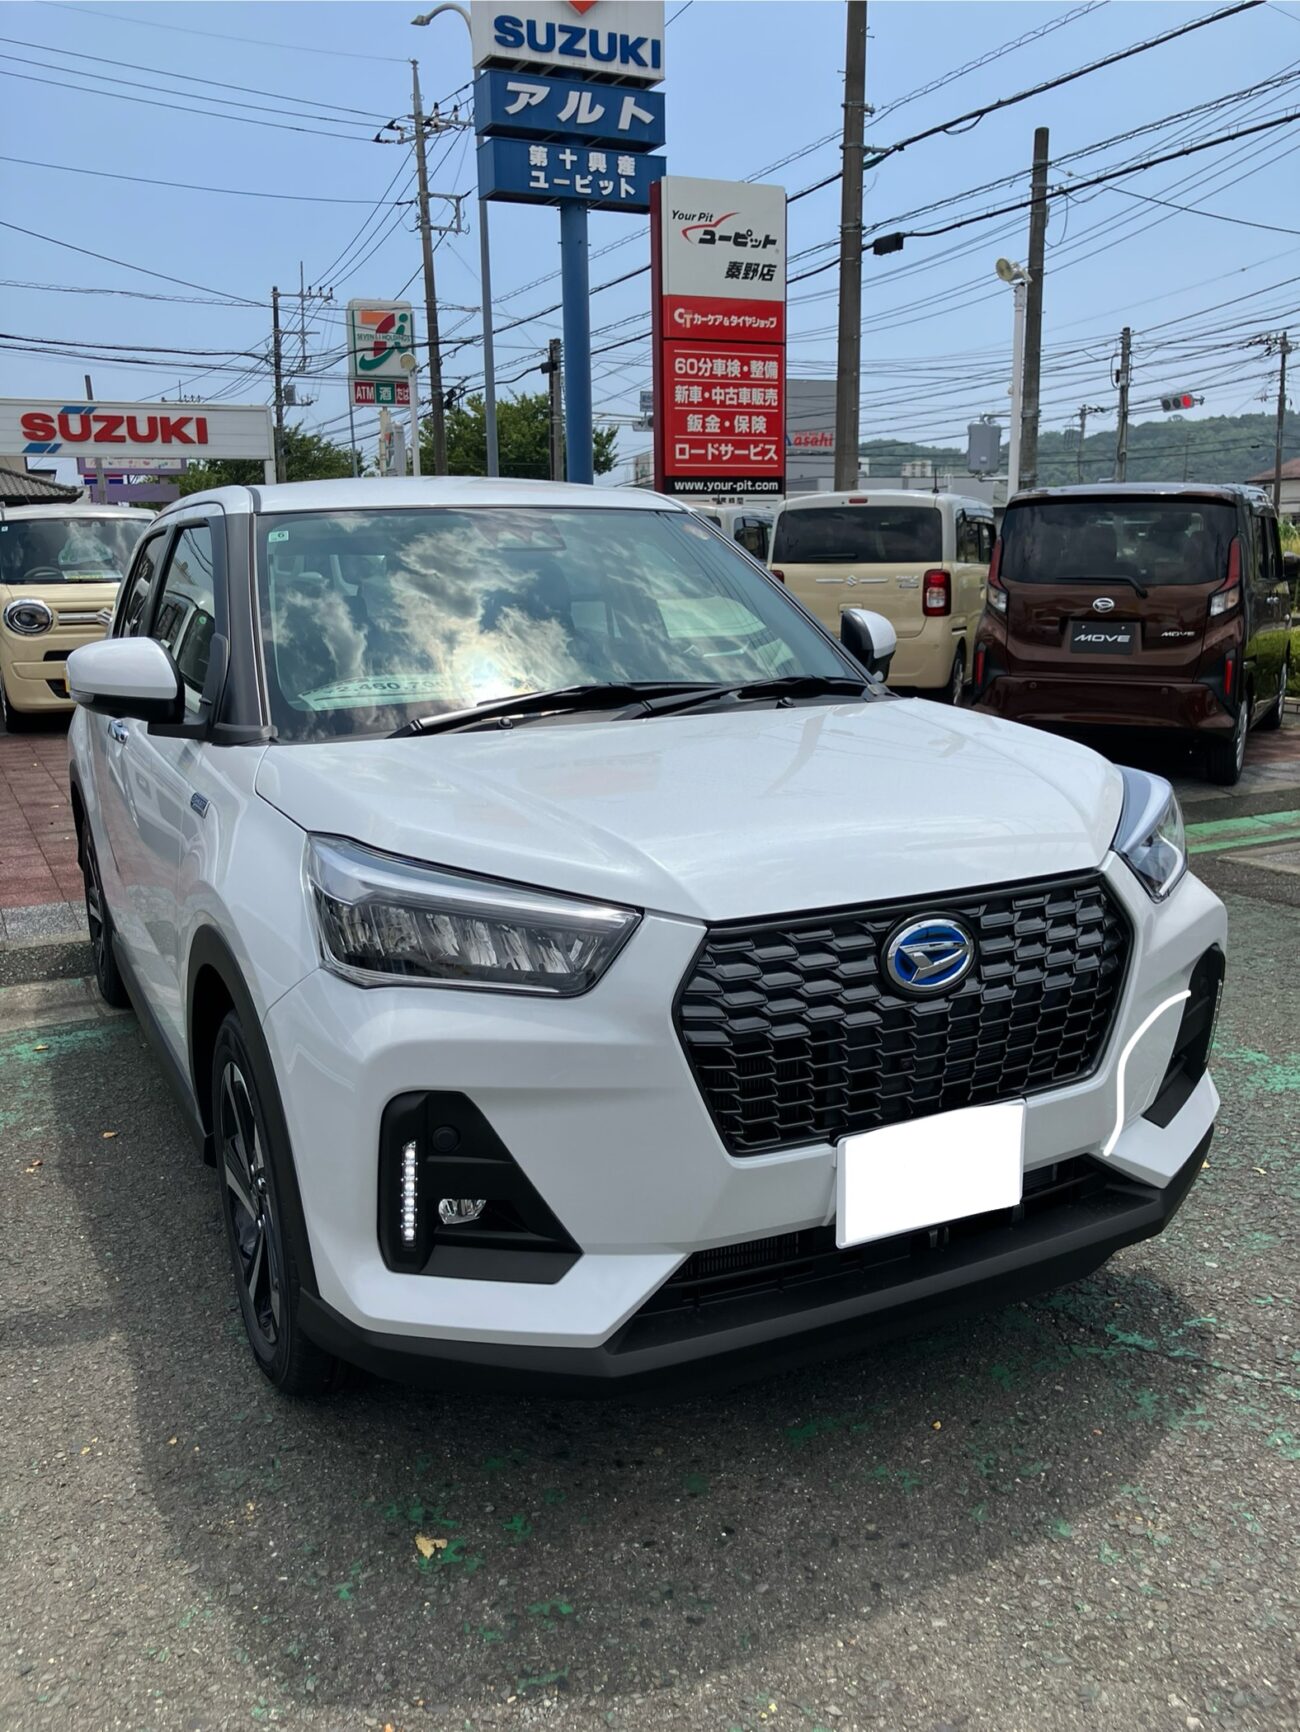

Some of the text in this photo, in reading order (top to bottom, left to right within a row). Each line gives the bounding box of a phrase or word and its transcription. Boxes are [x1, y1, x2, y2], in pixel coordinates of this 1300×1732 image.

[494, 15, 661, 69] SUZUKI
[504, 81, 655, 130] アルト
[528, 145, 635, 176] 第十興産
[529, 170, 635, 198] ユーピット
[672, 210, 713, 222] Your Pit
[698, 229, 777, 249] ユーピット
[724, 261, 777, 282] 秦野店
[674, 357, 778, 379] 60分車検・整備
[356, 386, 374, 400] ATM
[379, 386, 392, 400] 酒
[674, 385, 778, 406] 新車・中古車販売
[21, 413, 208, 444] SUZUKI
[675, 443, 778, 461] ロードサービス
[674, 480, 778, 491] www.your-pit.com
[1074, 634, 1131, 643] MOVE
